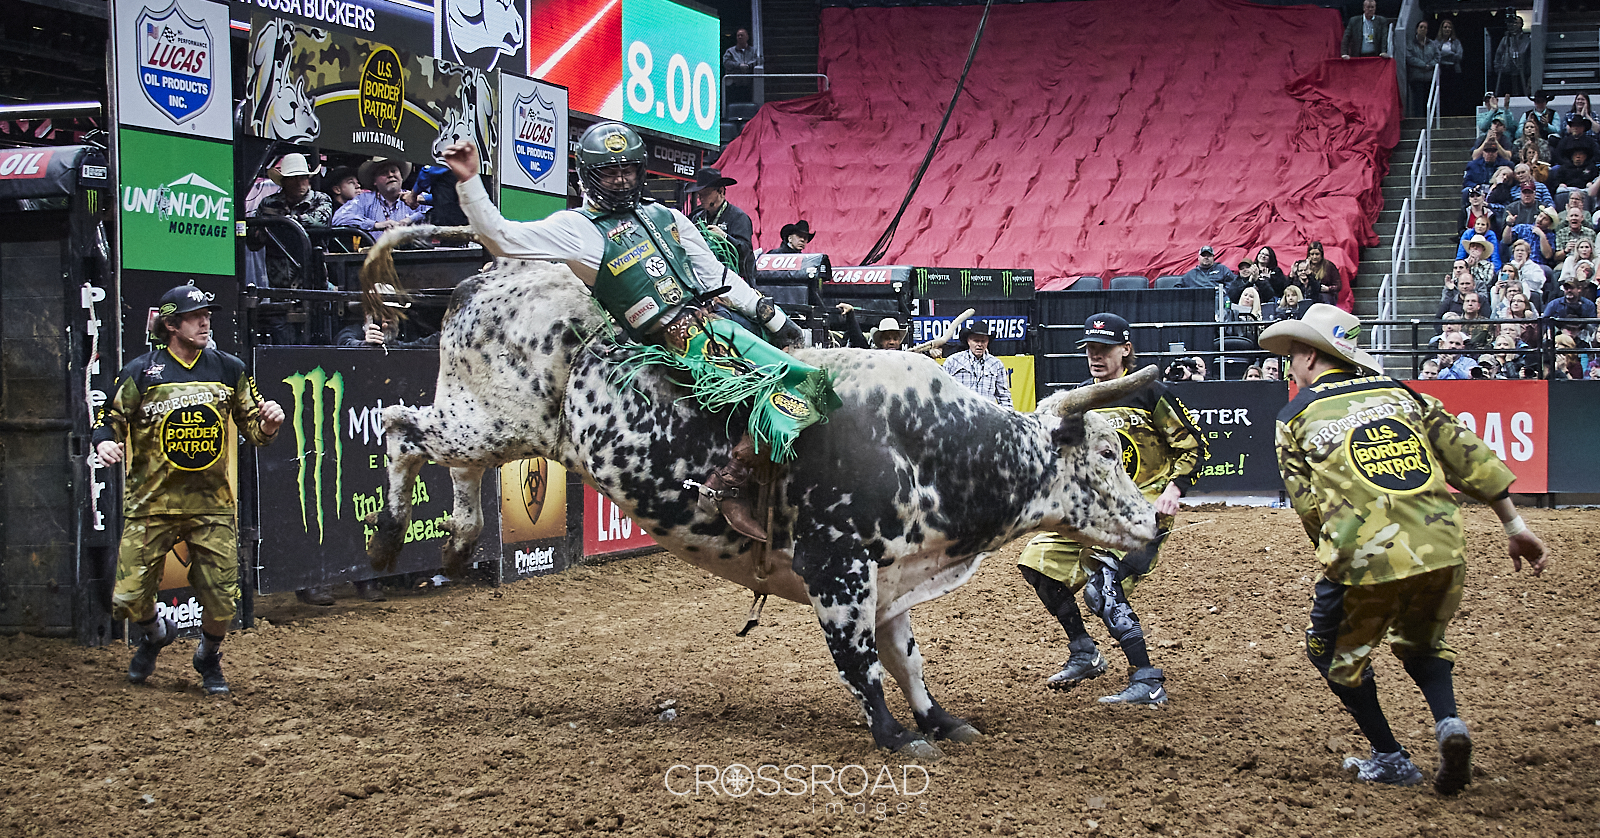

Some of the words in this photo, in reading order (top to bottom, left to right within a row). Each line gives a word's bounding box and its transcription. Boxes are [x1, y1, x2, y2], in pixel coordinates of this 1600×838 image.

[304, 0, 376, 32] BUCKERS
[148, 42, 206, 73] LUCAS
[377, 60, 393, 79] U.S.
[144, 72, 160, 87] OIL
[162, 76, 209, 95] PRODUCTS
[365, 79, 400, 103] BORDER
[626, 40, 717, 131] 8.00
[168, 94, 188, 109] INC.
[364, 101, 397, 121] PATROL
[353, 131, 405, 152] INVITATIONAL
[519, 121, 554, 144] LUCAS
[516, 144, 526, 155] OIL
[527, 147, 554, 161] PRODUCTS
[654, 145, 696, 166] COOPER
[0, 153, 45, 176] OIL
[673, 163, 695, 176] TIRES
[169, 221, 228, 238] MORTGAGE
[609, 242, 650, 270] Wrangler
[772, 256, 797, 269] OIL
[832, 270, 860, 283] CAS
[863, 270, 887, 283] OIL
[143, 390, 214, 417] PROTECTED
[181, 411, 206, 424] U.S.
[1310, 403, 1398, 451] PROTECTED
[166, 426, 219, 440] BORDER
[1364, 424, 1398, 442] U.S.
[167, 440, 218, 453] PATROL
[1355, 438, 1420, 463] BORDER
[1363, 455, 1424, 478] PATROL
[515, 545, 555, 569] Priefert
